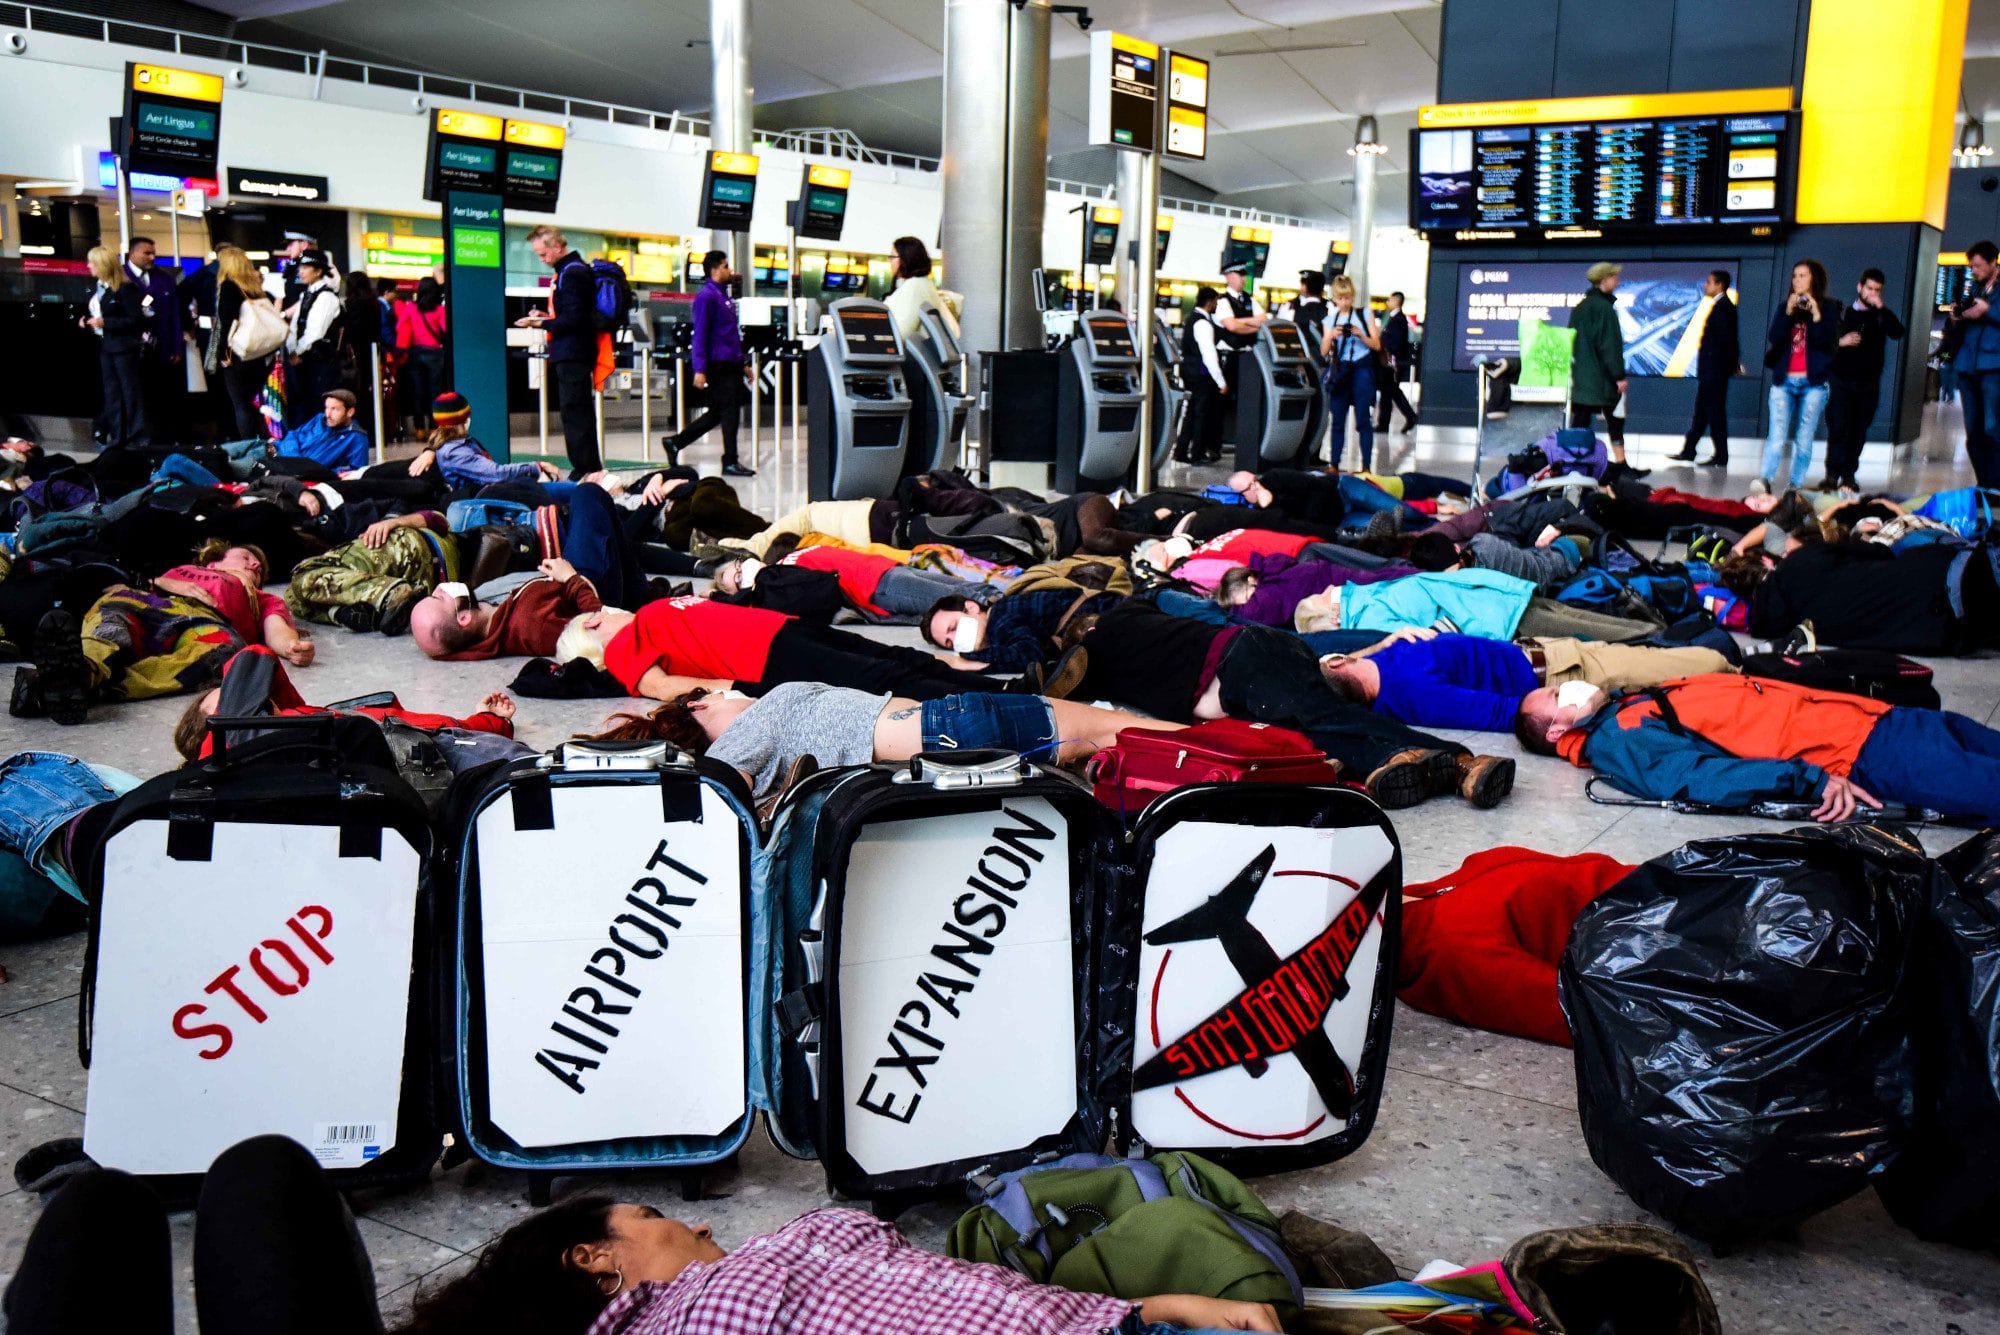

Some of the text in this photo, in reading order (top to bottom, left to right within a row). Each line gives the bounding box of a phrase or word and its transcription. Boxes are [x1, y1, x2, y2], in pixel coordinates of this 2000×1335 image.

[145, 112, 196, 131] Aer Lingus
[446, 150, 482, 164] Aer Lingus
[512, 159, 546, 173] Aer Lingus
[453, 206, 490, 221] Aer Lingus
[457, 233, 475, 244] Gold
[534, 838, 709, 1095] AIRPORT
[857, 805, 1058, 1125] EXPANSION
[172, 904, 336, 1061] STOP
[1164, 898, 1369, 1077] STAY GROUNDED
